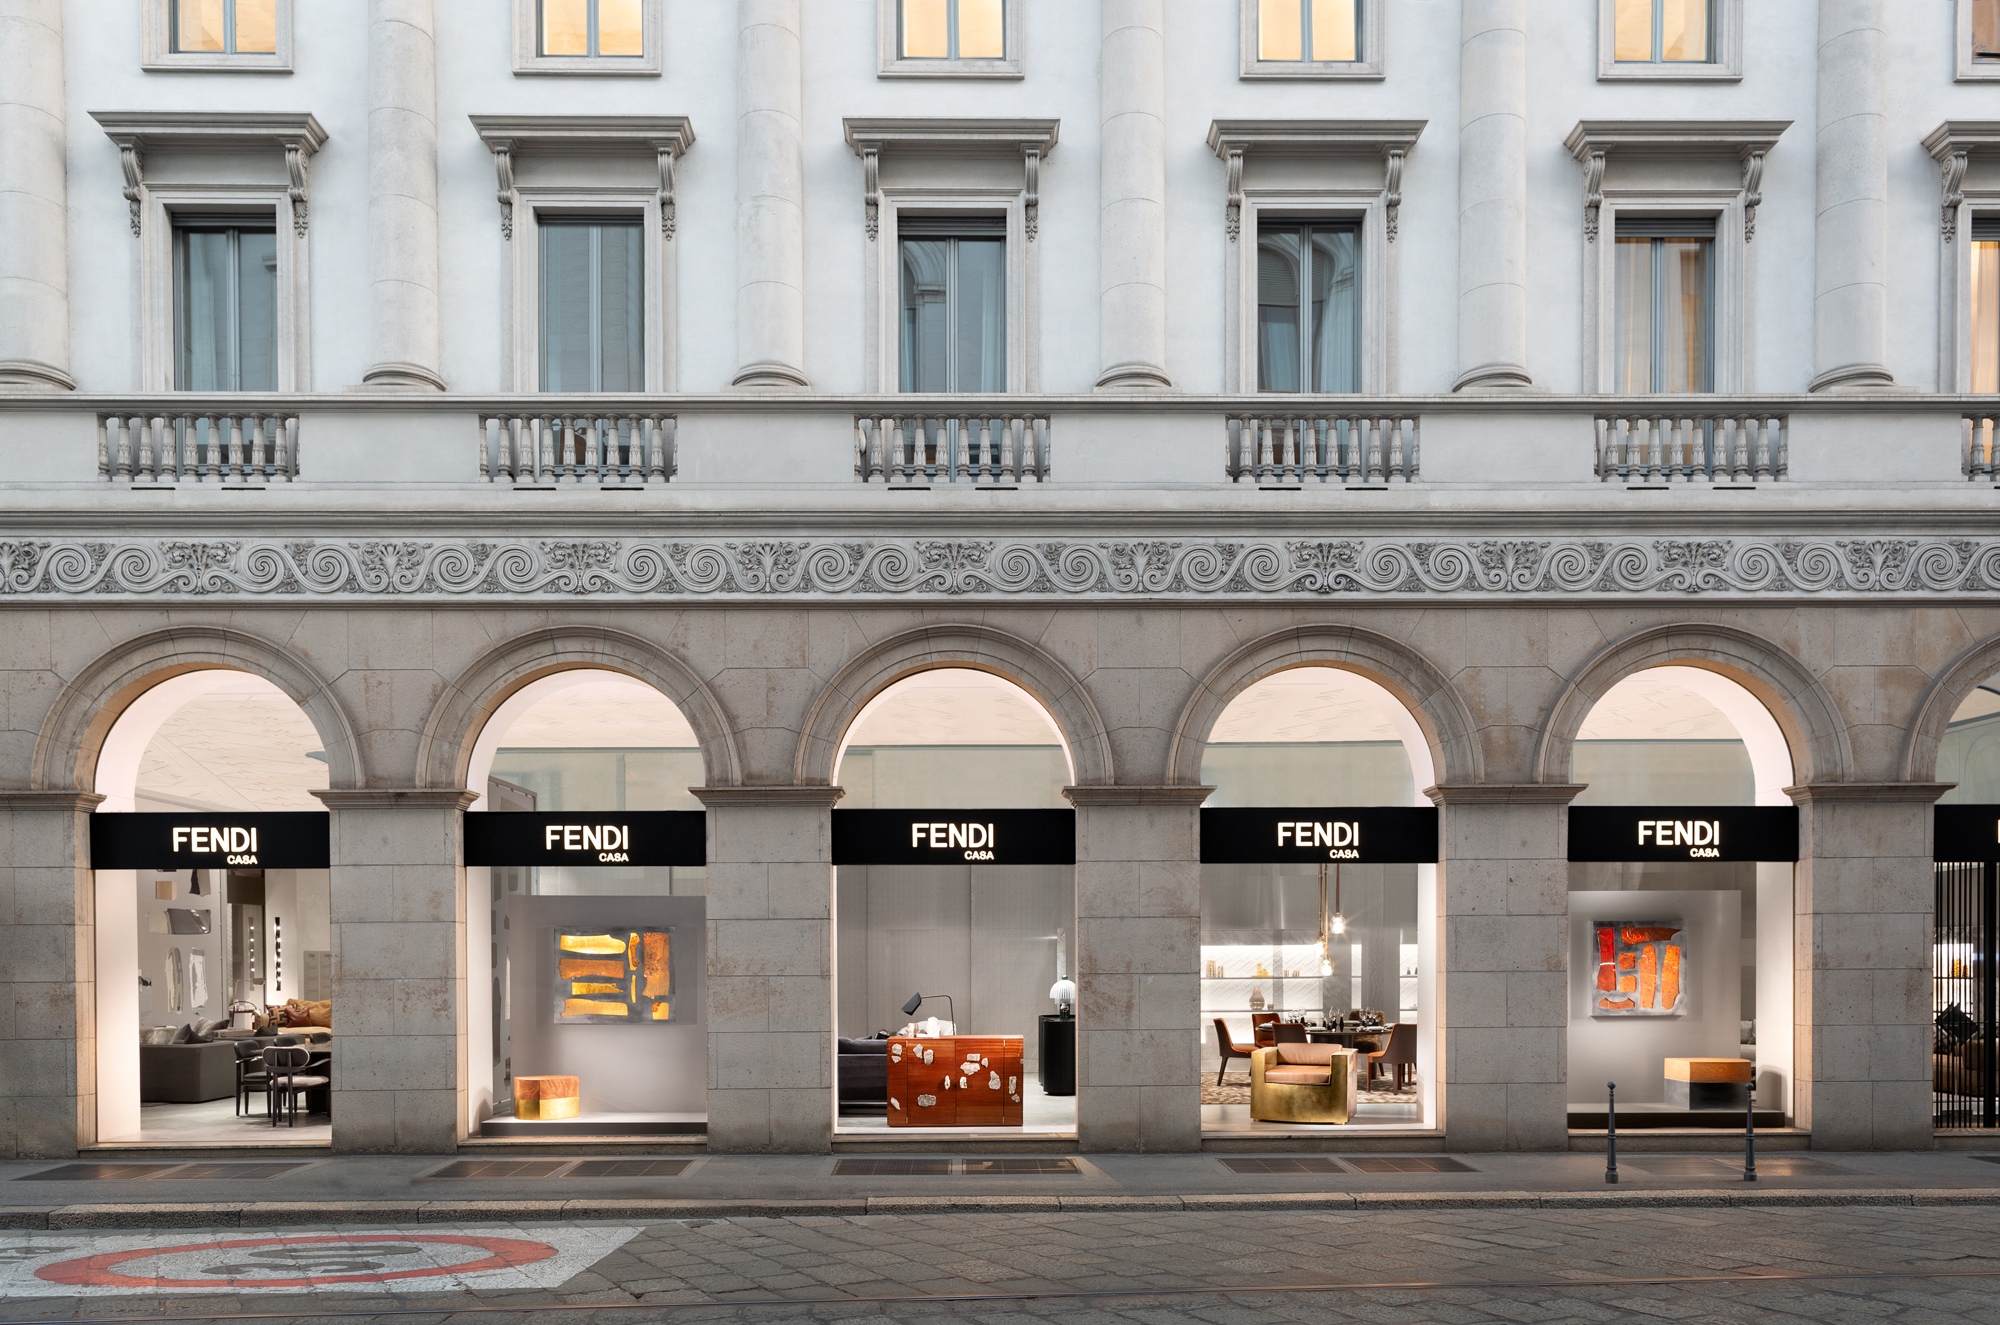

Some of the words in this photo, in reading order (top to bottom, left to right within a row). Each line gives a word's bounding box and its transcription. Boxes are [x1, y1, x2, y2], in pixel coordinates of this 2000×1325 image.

[173, 826, 257, 852] FENDI
[546, 825, 629, 850] FENDI
[911, 823, 994, 848] FENDI
[1278, 821, 1359, 846] FENDI
[1638, 820, 1720, 845] FENDI
[227, 854, 257, 864] CASA
[599, 853, 629, 863] CASA
[964, 850, 994, 860] CASA
[1330, 848, 1359, 859] CASA
[1690, 847, 1720, 858] CASA
